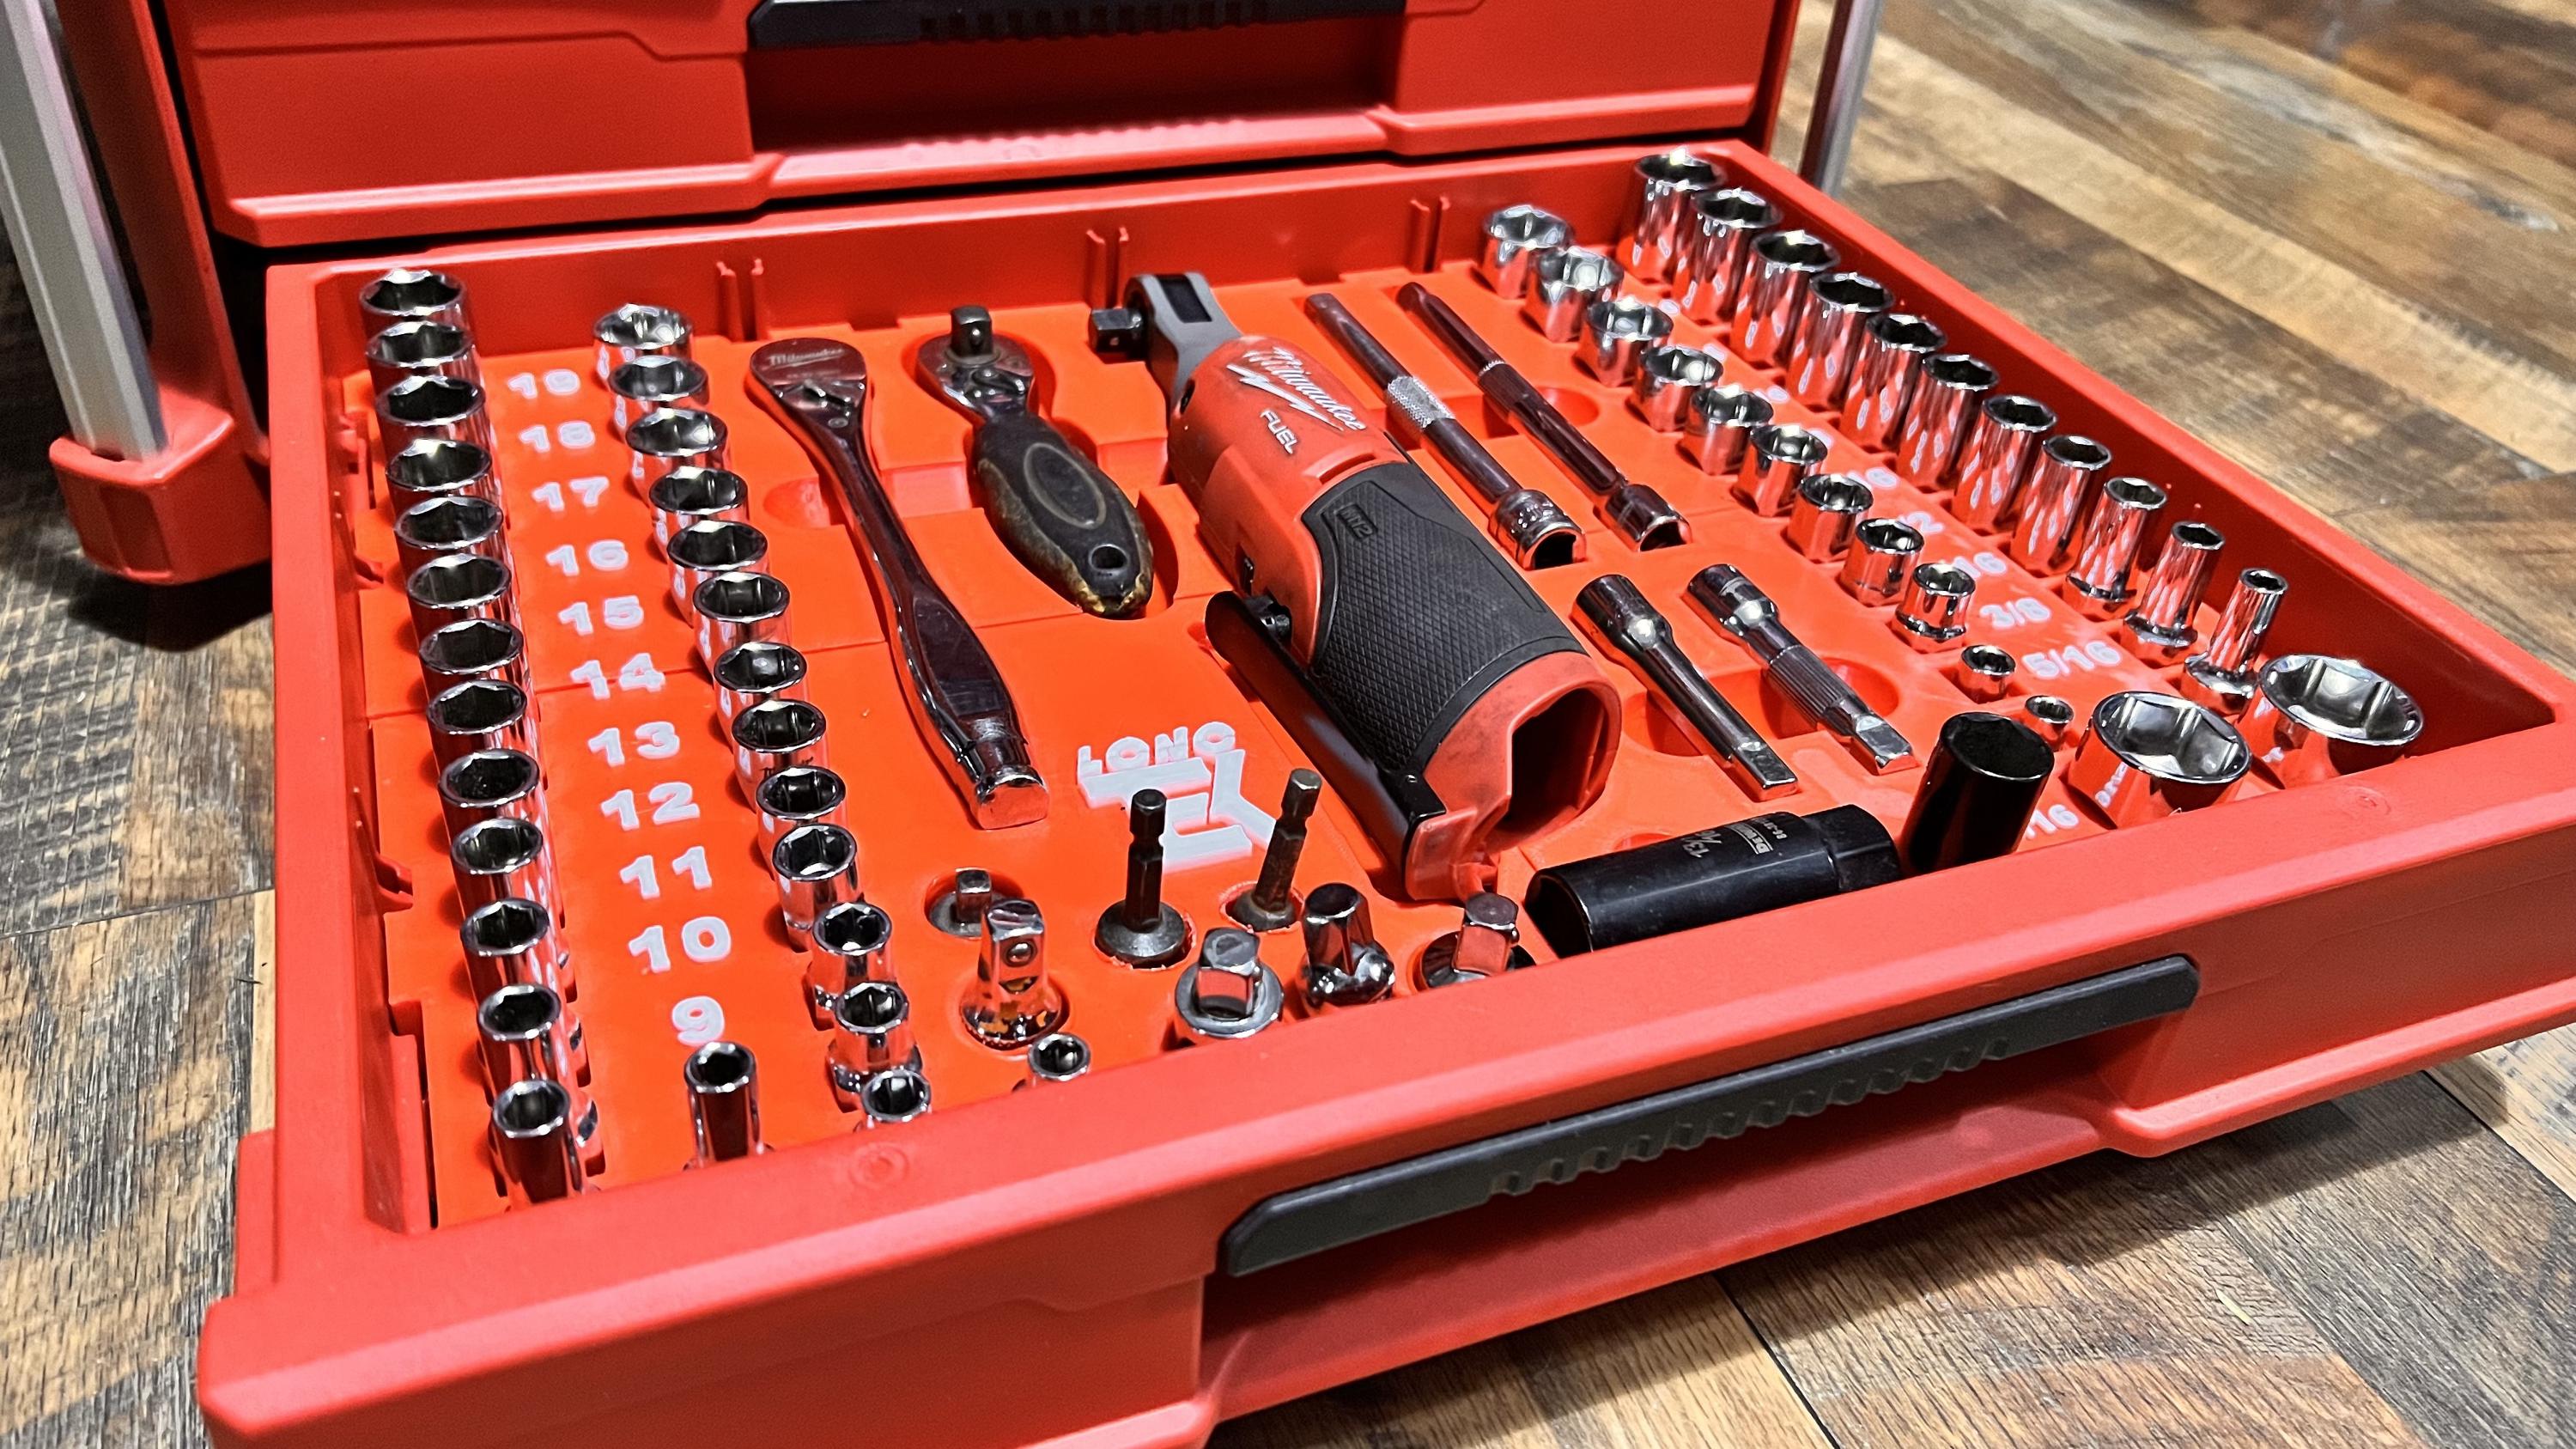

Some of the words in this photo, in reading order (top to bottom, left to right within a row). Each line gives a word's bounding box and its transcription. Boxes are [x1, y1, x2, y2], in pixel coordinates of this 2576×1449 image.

[507, 368, 580, 399] 19
[1242, 347, 1367, 430] Milwaukee
[519, 420, 596, 453] 18
[1260, 408, 1297, 454] FUEL
[532, 476, 610, 512] 17
[545, 539, 629, 576] 16
[558, 594, 644, 636] 15
[1979, 597, 2051, 629] 3/8
[571, 653, 665, 699] 14
[2021, 640, 2121, 679] 5/16
[588, 721, 680, 766] 13
[600, 782, 701, 831] 12
[620, 846, 713, 899] 11
[628, 916, 732, 973] 10
[671, 995, 725, 1046] 9
